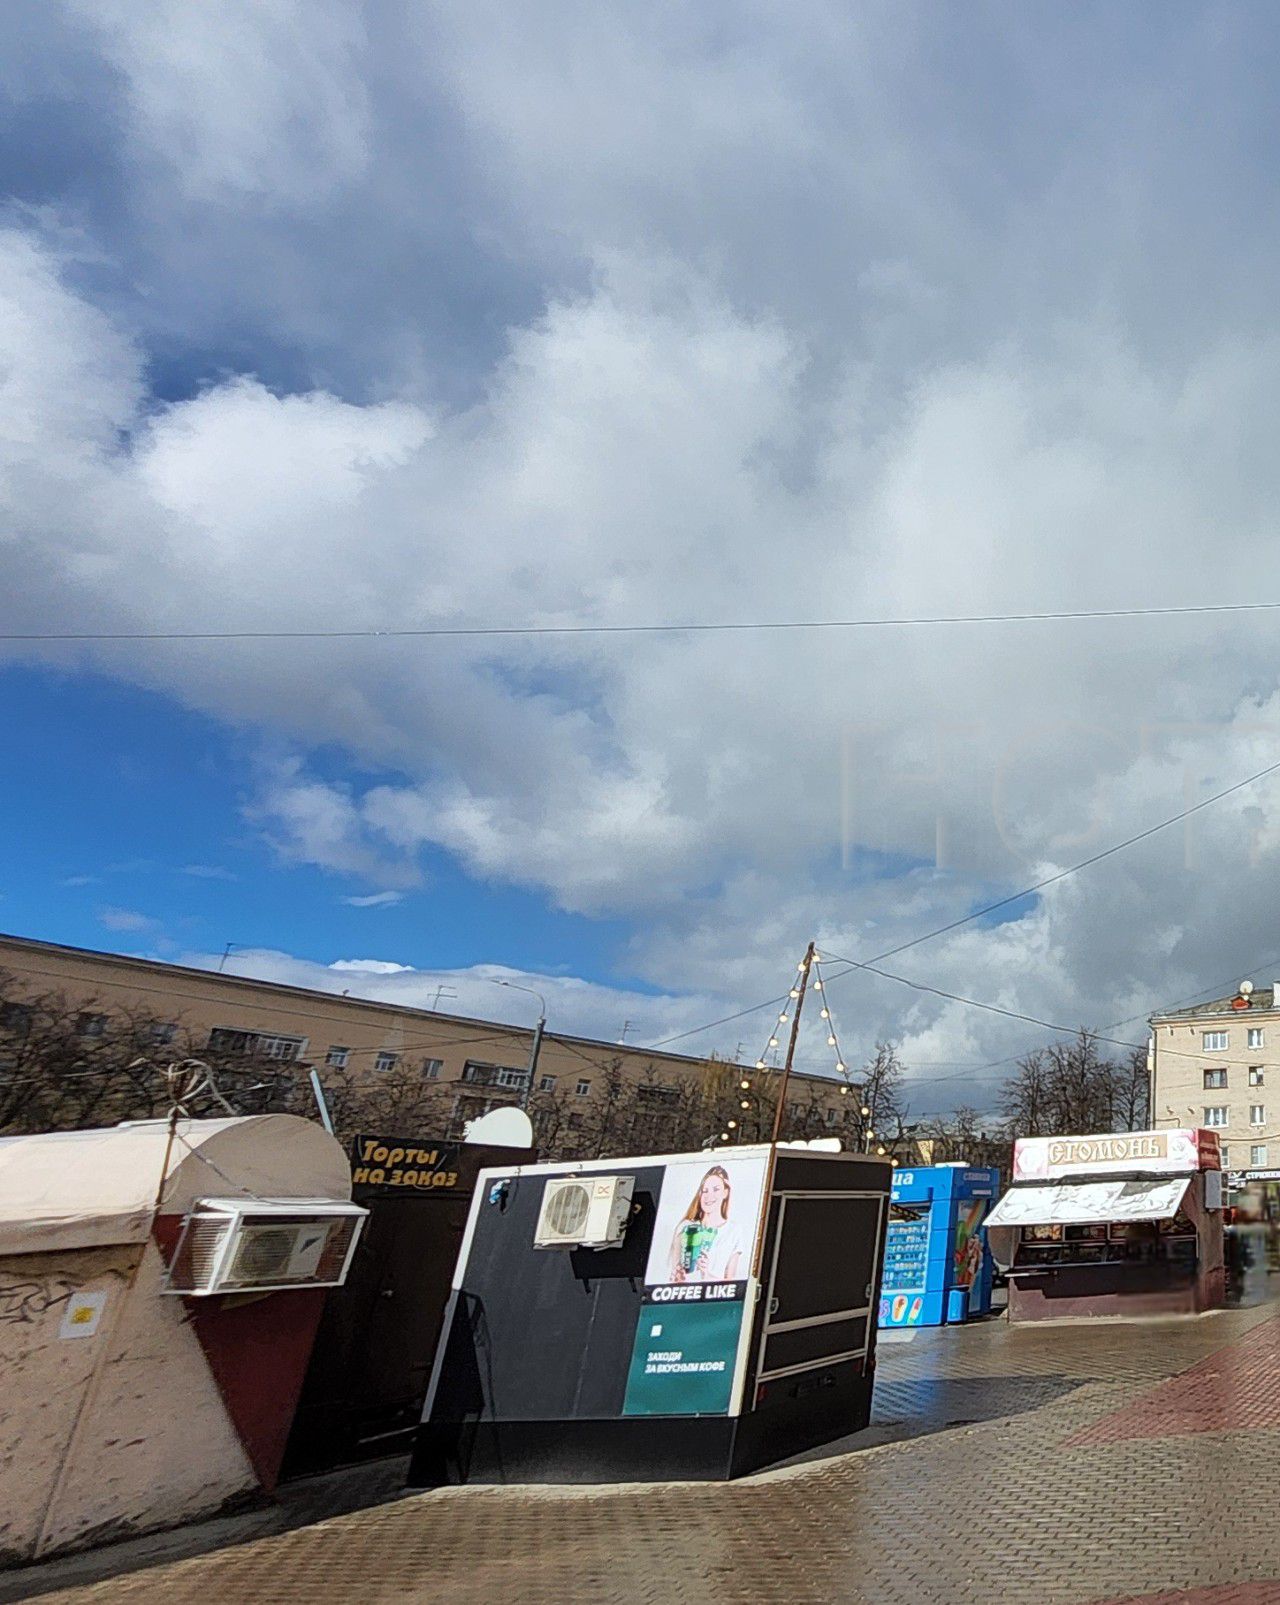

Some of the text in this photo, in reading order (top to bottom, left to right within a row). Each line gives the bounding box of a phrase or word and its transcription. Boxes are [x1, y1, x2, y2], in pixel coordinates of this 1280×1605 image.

[362, 1140, 438, 1168] Торты
[353, 1168, 457, 1187] на заказ
[651, 1284, 737, 1301] COFFEE LIKE
[647, 1352, 682, 1362] ЗАХОДИ
[645, 1361, 725, 1373] ЗА ВКУСНЫМ КОФЕ
